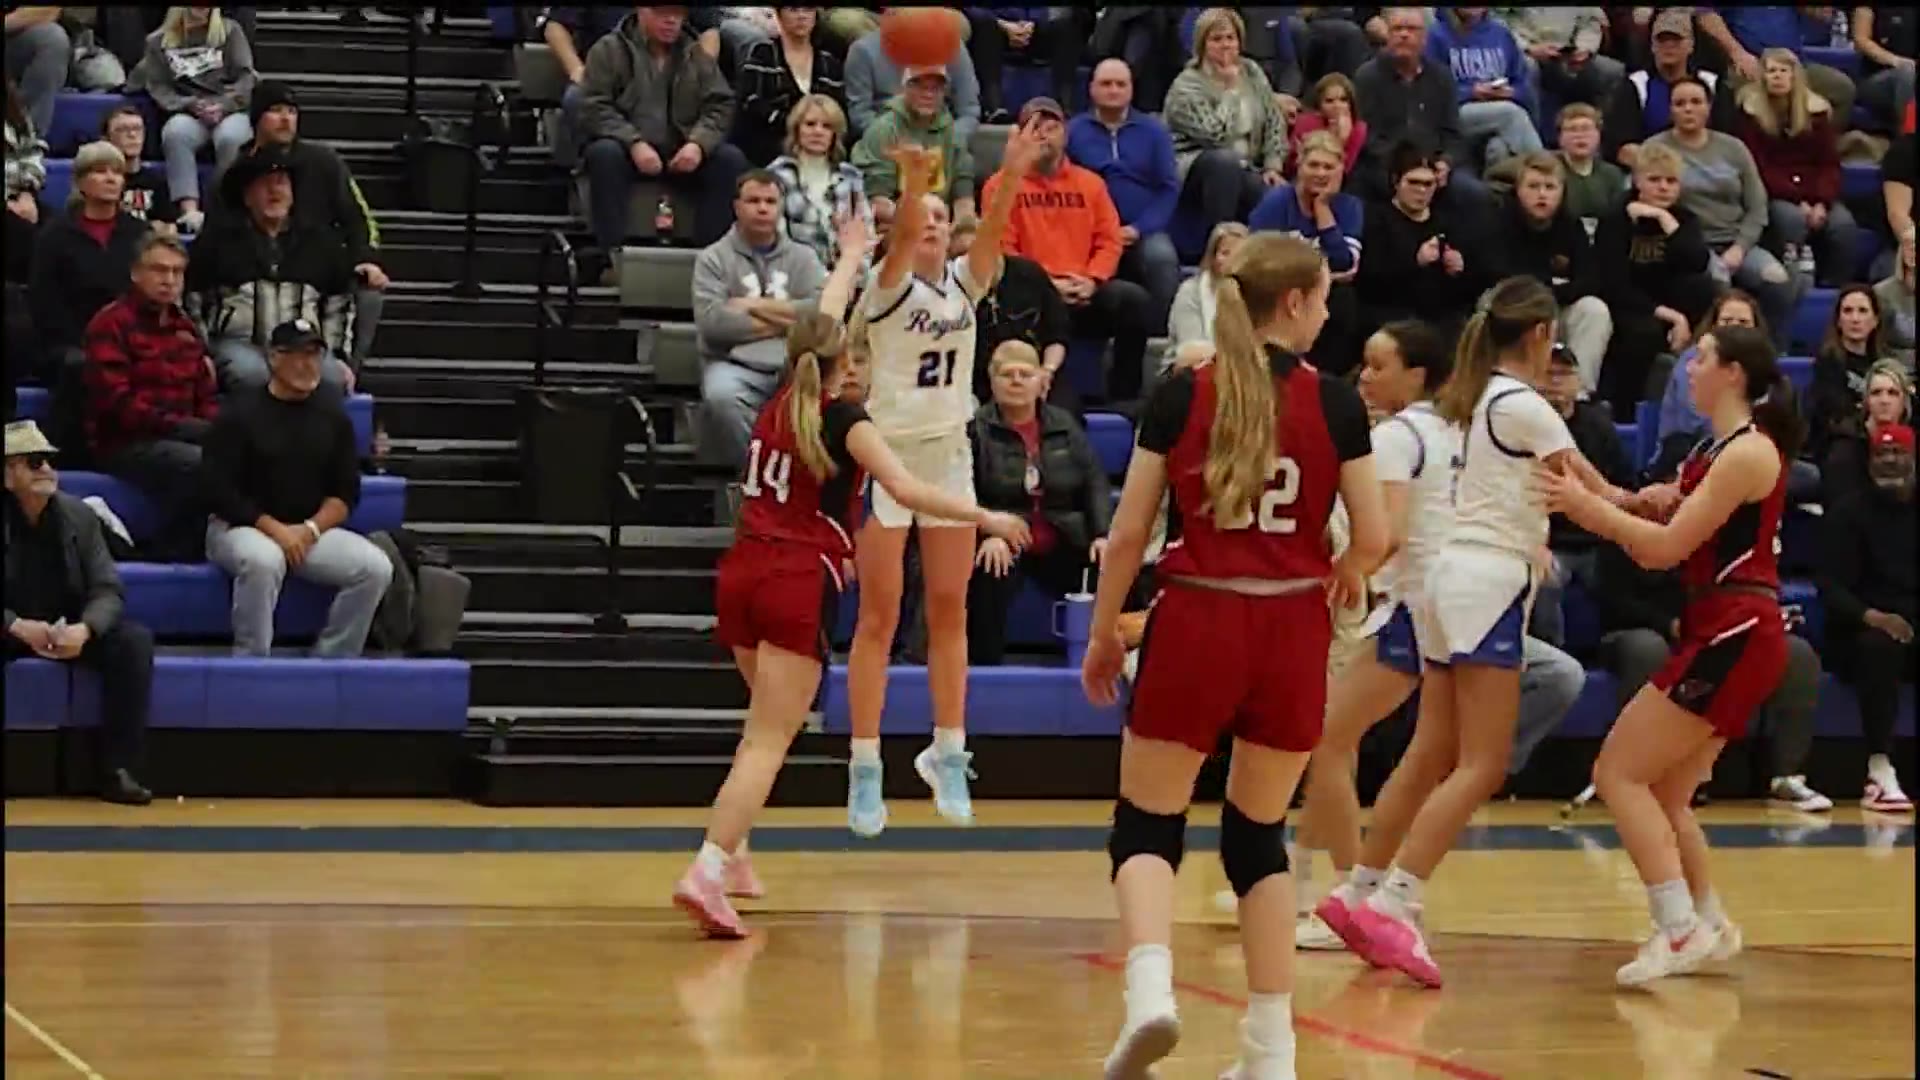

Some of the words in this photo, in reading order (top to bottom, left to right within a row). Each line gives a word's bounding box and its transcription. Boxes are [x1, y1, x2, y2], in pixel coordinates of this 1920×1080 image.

[917, 348, 957, 387] 21
[742, 438, 792, 504] 14
[1222, 456, 1301, 534] 2
